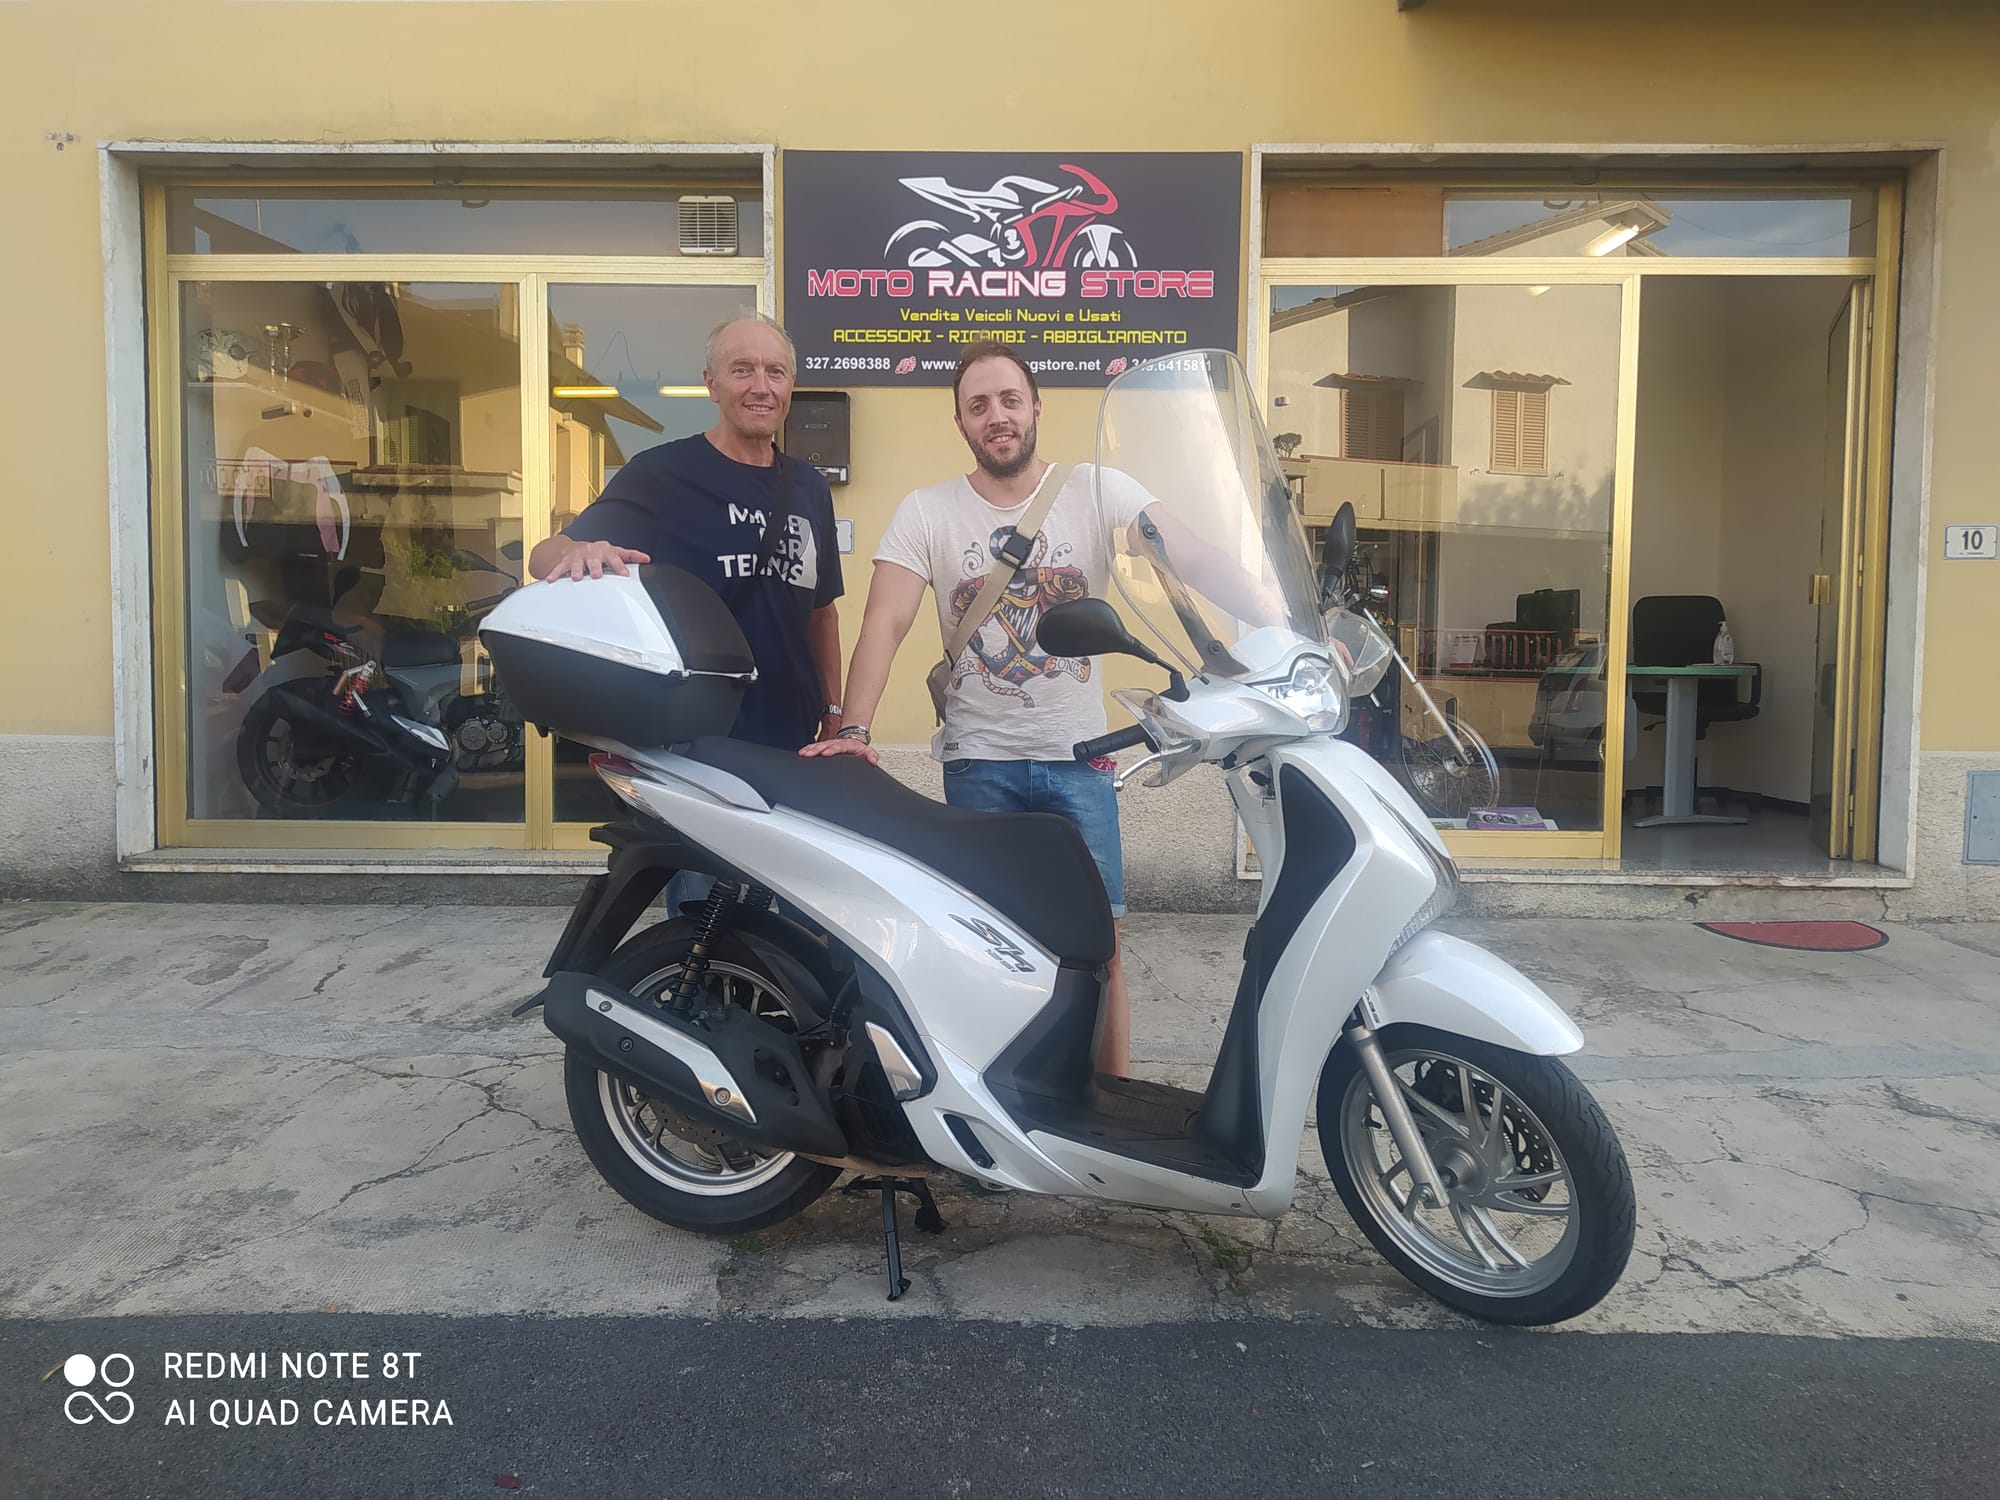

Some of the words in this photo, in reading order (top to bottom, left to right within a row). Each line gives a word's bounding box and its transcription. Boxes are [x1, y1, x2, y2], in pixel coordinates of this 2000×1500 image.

[808, 269, 913, 297] MOTO
[928, 269, 1067, 298] RACING
[1081, 270, 1214, 297] STORE
[900, 308, 960, 322] Vendita
[964, 308, 1012, 322] Veicoli
[1016, 308, 1060, 322] Nuovi
[1064, 313, 1075, 322] e
[1079, 308, 1121, 322] Usati
[833, 329, 932, 343] ACCESSORI
[948, 330, 1026, 343] RICAMBI
[1042, 330, 1188, 344] ABBIGLIAMENTO
[805, 357, 891, 370] 327.2698388
[1962, 530, 1983, 550] 10
[1047, 657, 1087, 680] SONGS
